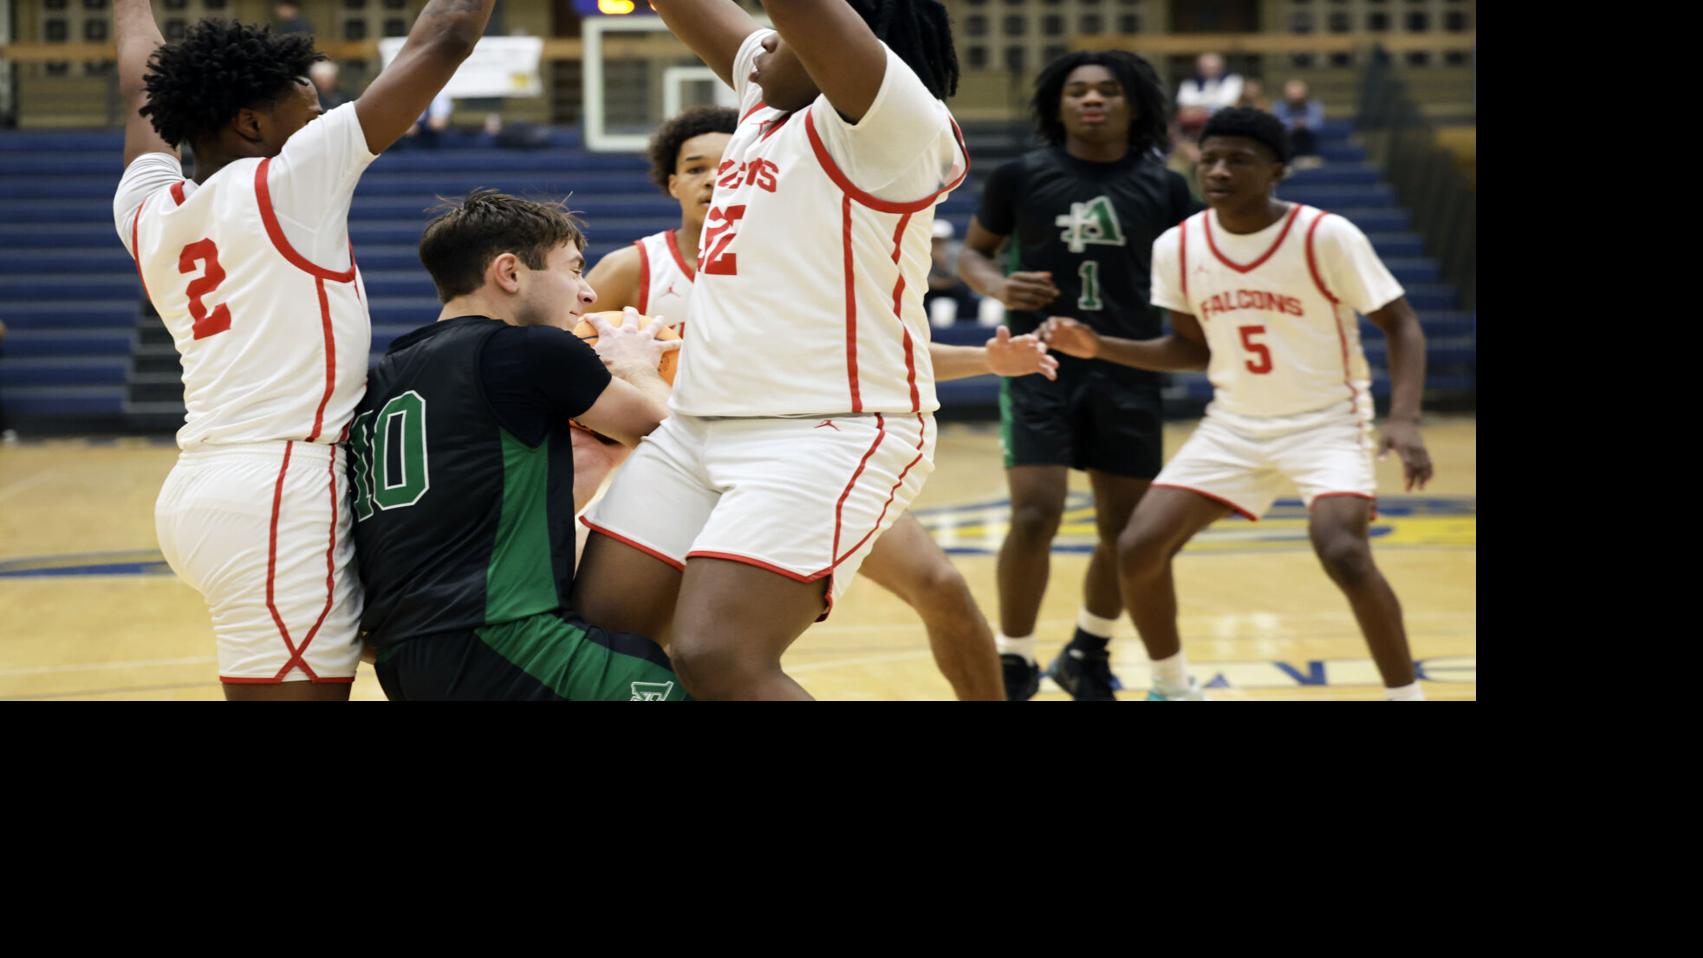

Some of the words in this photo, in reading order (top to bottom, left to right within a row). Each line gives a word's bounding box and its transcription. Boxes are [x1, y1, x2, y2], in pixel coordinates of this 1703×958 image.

[178, 237, 232, 341] 2
[1077, 260, 1103, 310] 1
[1200, 289, 1304, 321] FALCONS
[1238, 325, 1273, 375] 5
[350, 390, 430, 523] 10
